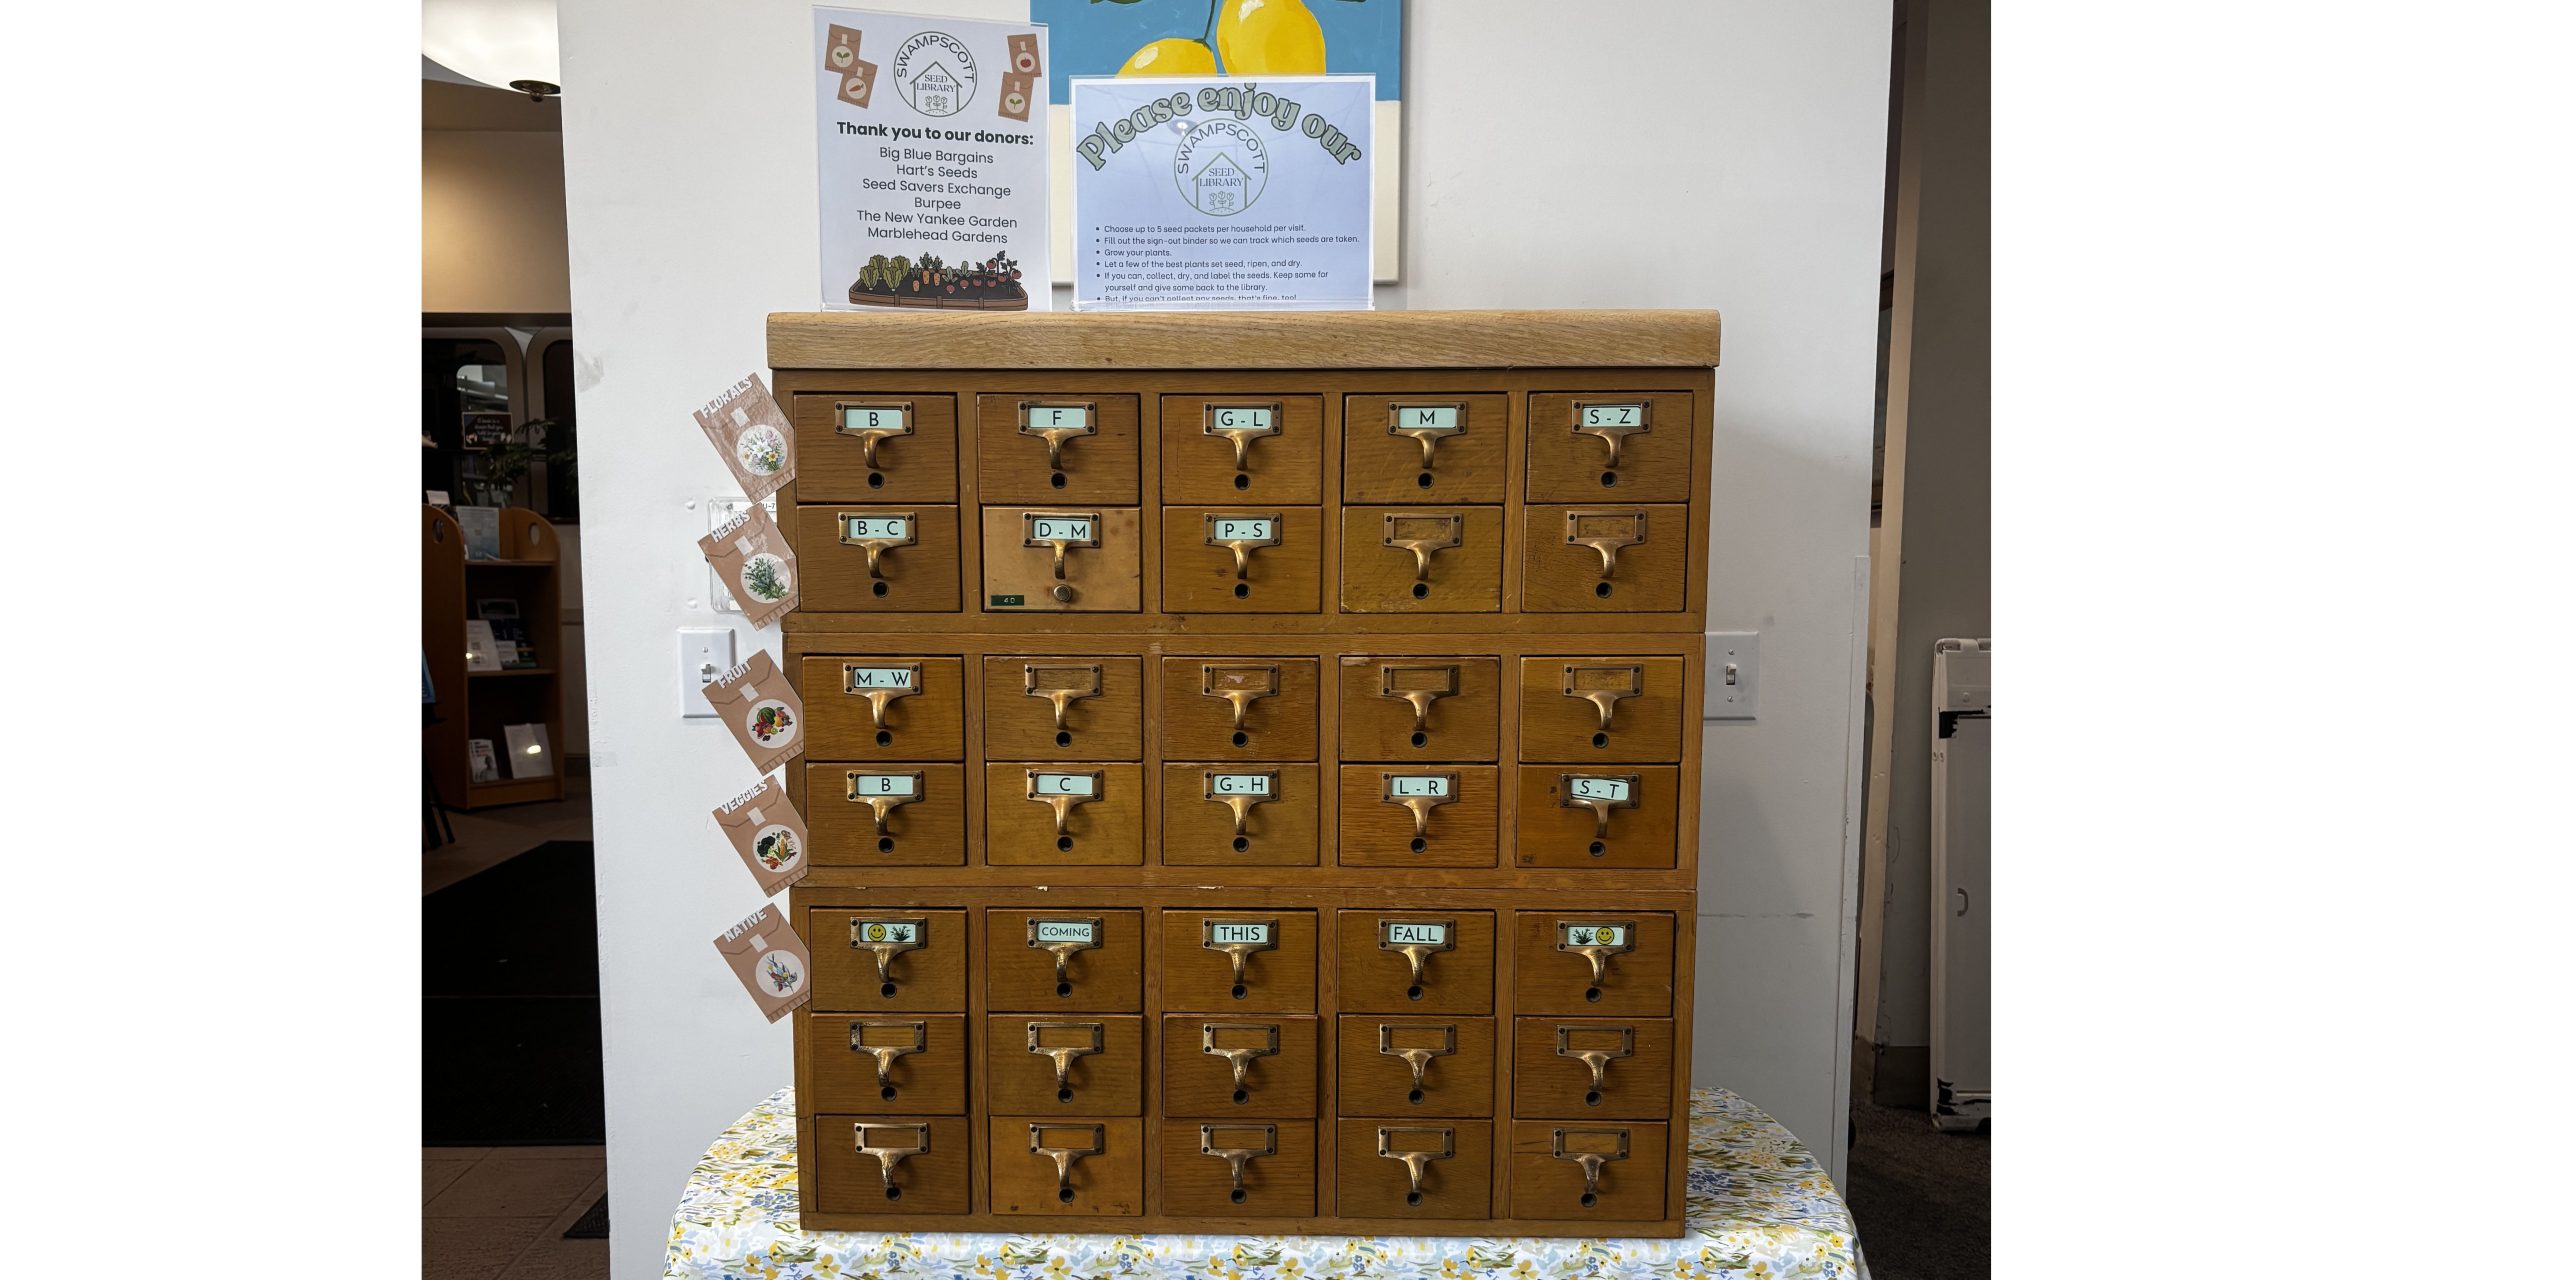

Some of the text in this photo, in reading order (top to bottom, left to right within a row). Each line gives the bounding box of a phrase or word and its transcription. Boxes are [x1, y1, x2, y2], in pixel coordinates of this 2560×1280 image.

[897, 35, 974, 83] SWAMPSCOTT
[924, 74, 948, 83] SEED
[917, 83, 955, 92] LIBRARY
[837, 121, 1034, 145] Thank you to our donors:
[1076, 82, 1362, 171] Please enjoy our
[880, 147, 994, 165] Big Blue Bargains
[1178, 123, 1265, 174] SWAMPSCOTT
[896, 164, 978, 179] Hart's Seeds
[1208, 168, 1235, 177] SEED
[862, 179, 1011, 199] Seed Savers Exchange
[1199, 177, 1243, 187] LIBRARY
[915, 197, 961, 212] Burpee
[857, 210, 1017, 228] The New Yankee Garden
[868, 227, 1008, 244] Marblehead Gardens
[1104, 224, 1306, 234] Choose up to 5 seed packets per household per visit.
[1104, 237, 1117, 245] Fill
[1132, 237, 1146, 245] the
[1147, 237, 1181, 246] sign-out
[1182, 237, 1207, 245] binder
[1249, 236, 1269, 244] track
[1271, 236, 1295, 244] which
[1296, 235, 1320, 243] seeds
[1335, 235, 1360, 243] taken.
[1104, 248, 1173, 258] Grow your plants.
[1104, 260, 1117, 268] Let
[1125, 260, 1140, 268] few
[1141, 260, 1150, 268] of
[1151, 260, 1164, 268] the
[1165, 260, 1183, 268] best
[1184, 260, 1209, 269] plants
[1210, 260, 1223, 268] set
[1224, 259, 1246, 268] seed,
[1247, 259, 1270, 268] ripen,
[1271, 259, 1287, 267] and
[1287, 259, 1303, 268] dry.
[1111, 273, 1126, 281] you
[1127, 273, 1145, 281] can,
[1146, 272, 1176, 281] collect,
[1177, 272, 1192, 281] dry,
[1193, 272, 1209, 280] and
[1210, 271, 1231, 279] label
[1232, 271, 1246, 279] the
[1247, 271, 1272, 279] seeds.
[1273, 271, 1293, 280] Keep
[1294, 271, 1316, 279] some
[1317, 270, 1328, 278] for
[1105, 284, 1136, 292] yourself
[1137, 283, 1154, 291] and
[1154, 284, 1171, 292] give
[1172, 284, 1195, 292] some
[1196, 283, 1215, 291] back
[1226, 283, 1240, 291] the
[1240, 283, 1268, 292] library.
[700, 376, 753, 419] FLORALS
[869, 411, 879, 427] B
[1053, 410, 1063, 426] F
[1221, 411, 1234, 427] G
[1253, 411, 1264, 427] L
[1420, 410, 1436, 426] M
[1589, 409, 1600, 424] S
[1619, 409, 1632, 424] Z
[711, 510, 751, 543] HERBS
[857, 520, 868, 536] B
[886, 520, 899, 536] C
[1039, 522, 1052, 538] D
[1070, 524, 1087, 539] M
[1224, 523, 1235, 538] P
[1252, 522, 1264, 538] S
[716, 660, 752, 689] FRUIT
[856, 671, 873, 687] M
[890, 671, 909, 687] W
[881, 777, 891, 792] B
[1059, 777, 1071, 792] C
[1220, 777, 1233, 792] G
[1251, 777, 1264, 792] H
[1400, 780, 1409, 795] L
[1428, 780, 1439, 795] R
[1580, 780, 1591, 795] S
[1609, 783, 1621, 799] T
[720, 780, 770, 816] VEGGIES
[723, 909, 769, 943] NATIVE
[1041, 926, 1090, 938] COMING
[1220, 926, 1261, 941] THIS
[1393, 926, 1438, 942] FALL
